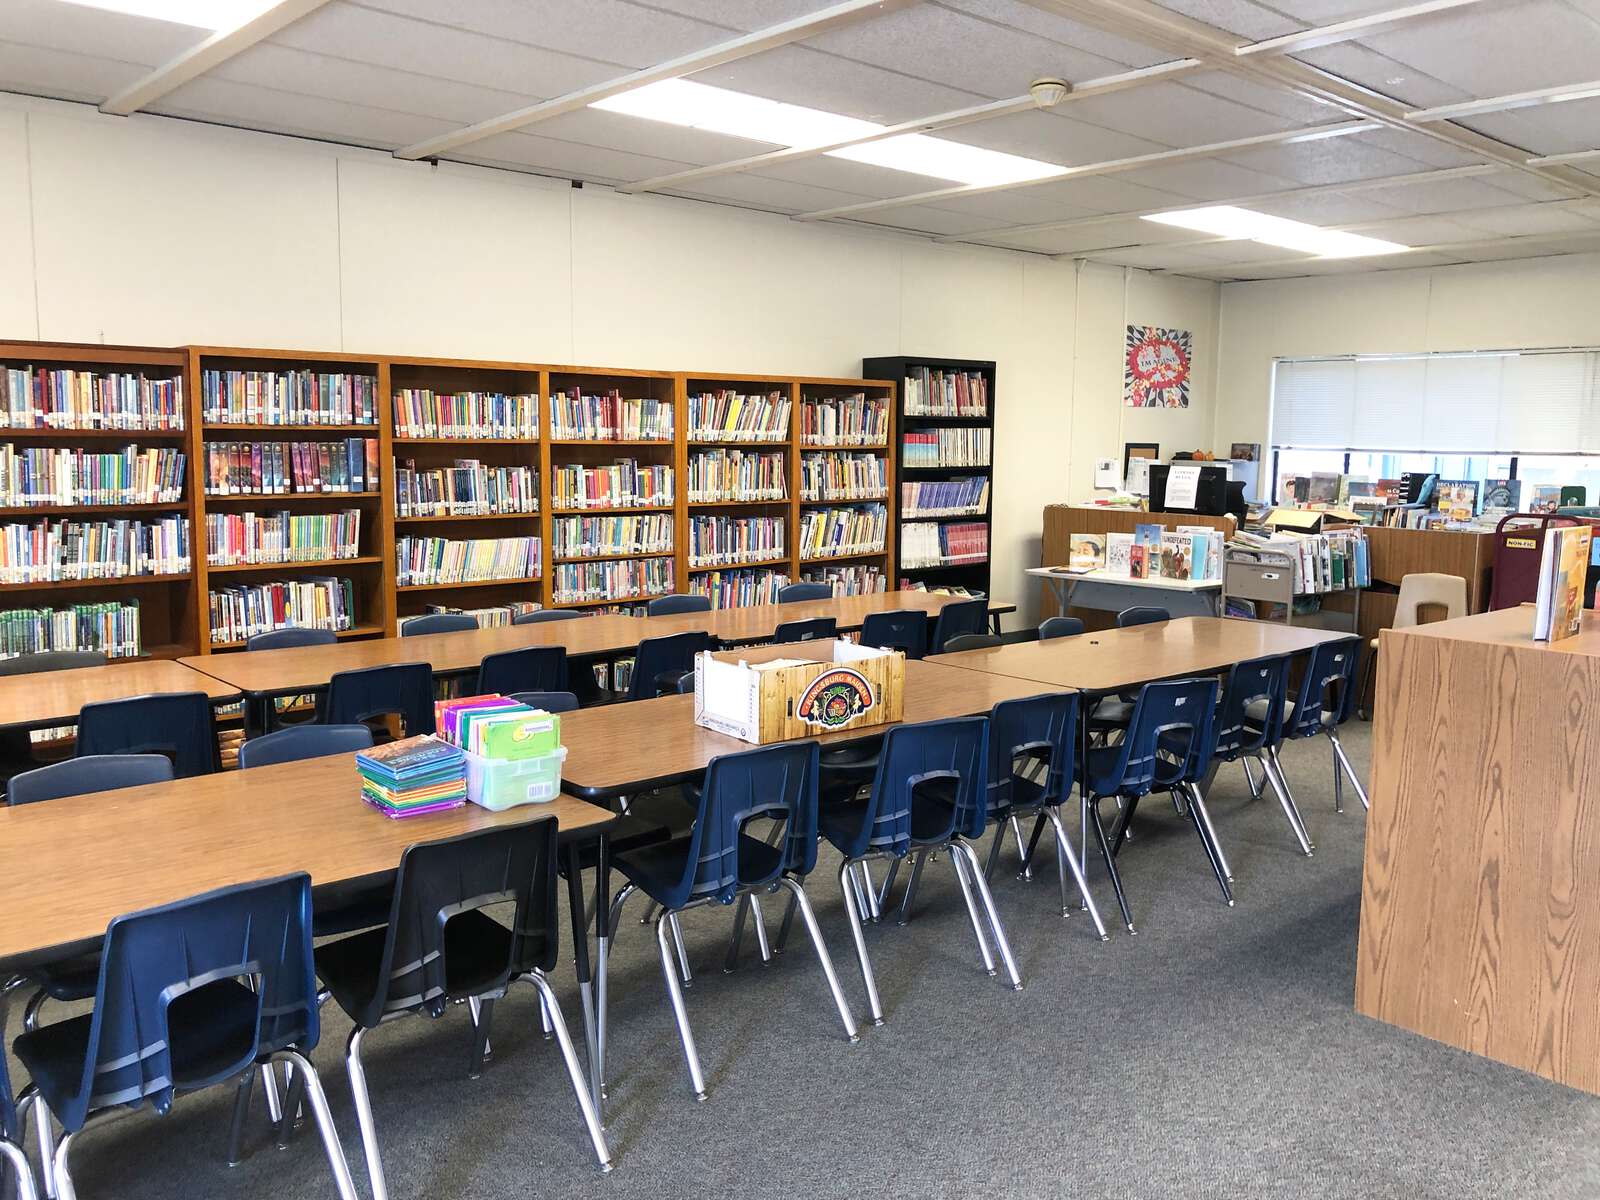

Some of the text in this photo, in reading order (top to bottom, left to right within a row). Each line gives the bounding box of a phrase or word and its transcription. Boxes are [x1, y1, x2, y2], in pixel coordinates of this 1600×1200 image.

[1141, 357, 1175, 367] IMAGINE
[1398, 472, 1410, 504] HALES
[1164, 535, 1191, 545] UNDEFEATED
[806, 674, 866, 706] KINGSBURG MAIDEN
